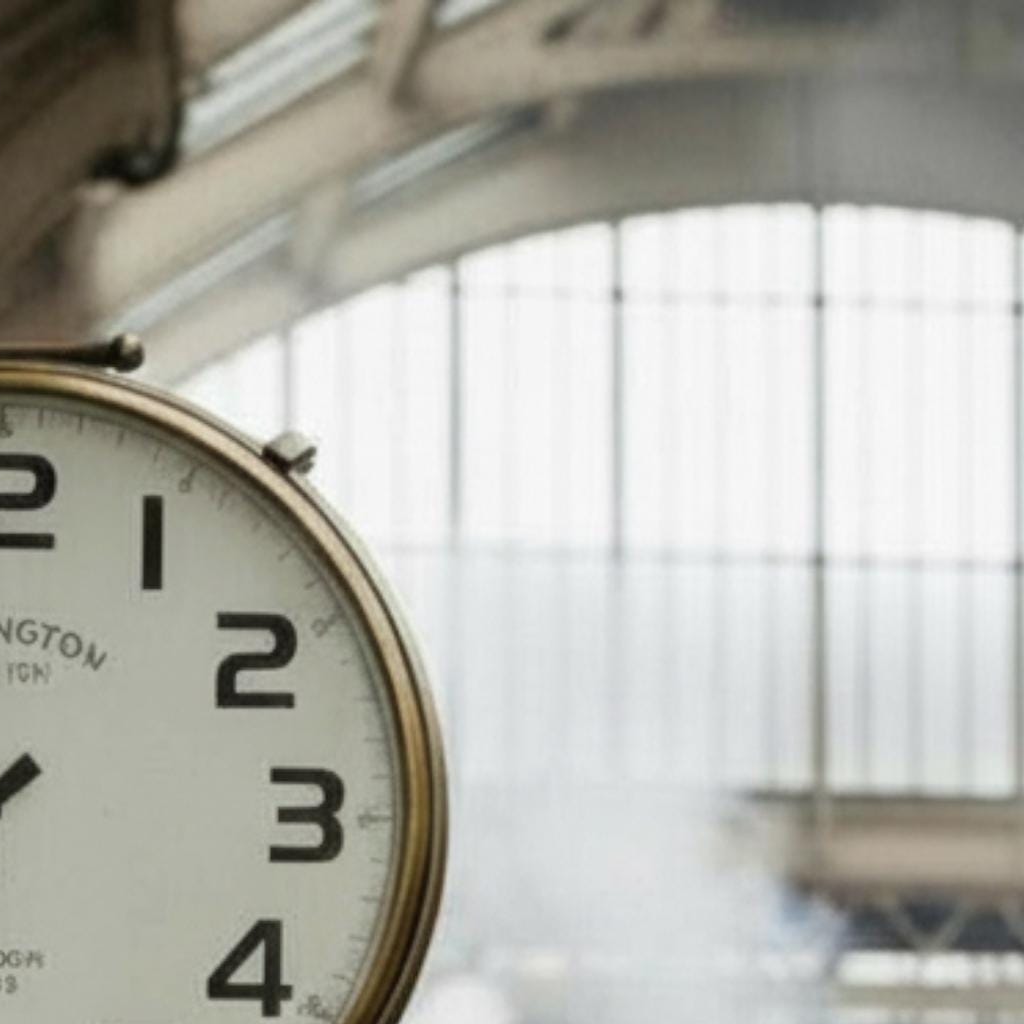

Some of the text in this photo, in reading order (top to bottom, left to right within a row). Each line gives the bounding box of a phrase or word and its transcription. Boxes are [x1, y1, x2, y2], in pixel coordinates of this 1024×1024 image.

[142, 495, 163, 590] 1
[216, 612, 297, 708] 2
[269, 768, 344, 863] 3
[207, 920, 292, 1017] 4
